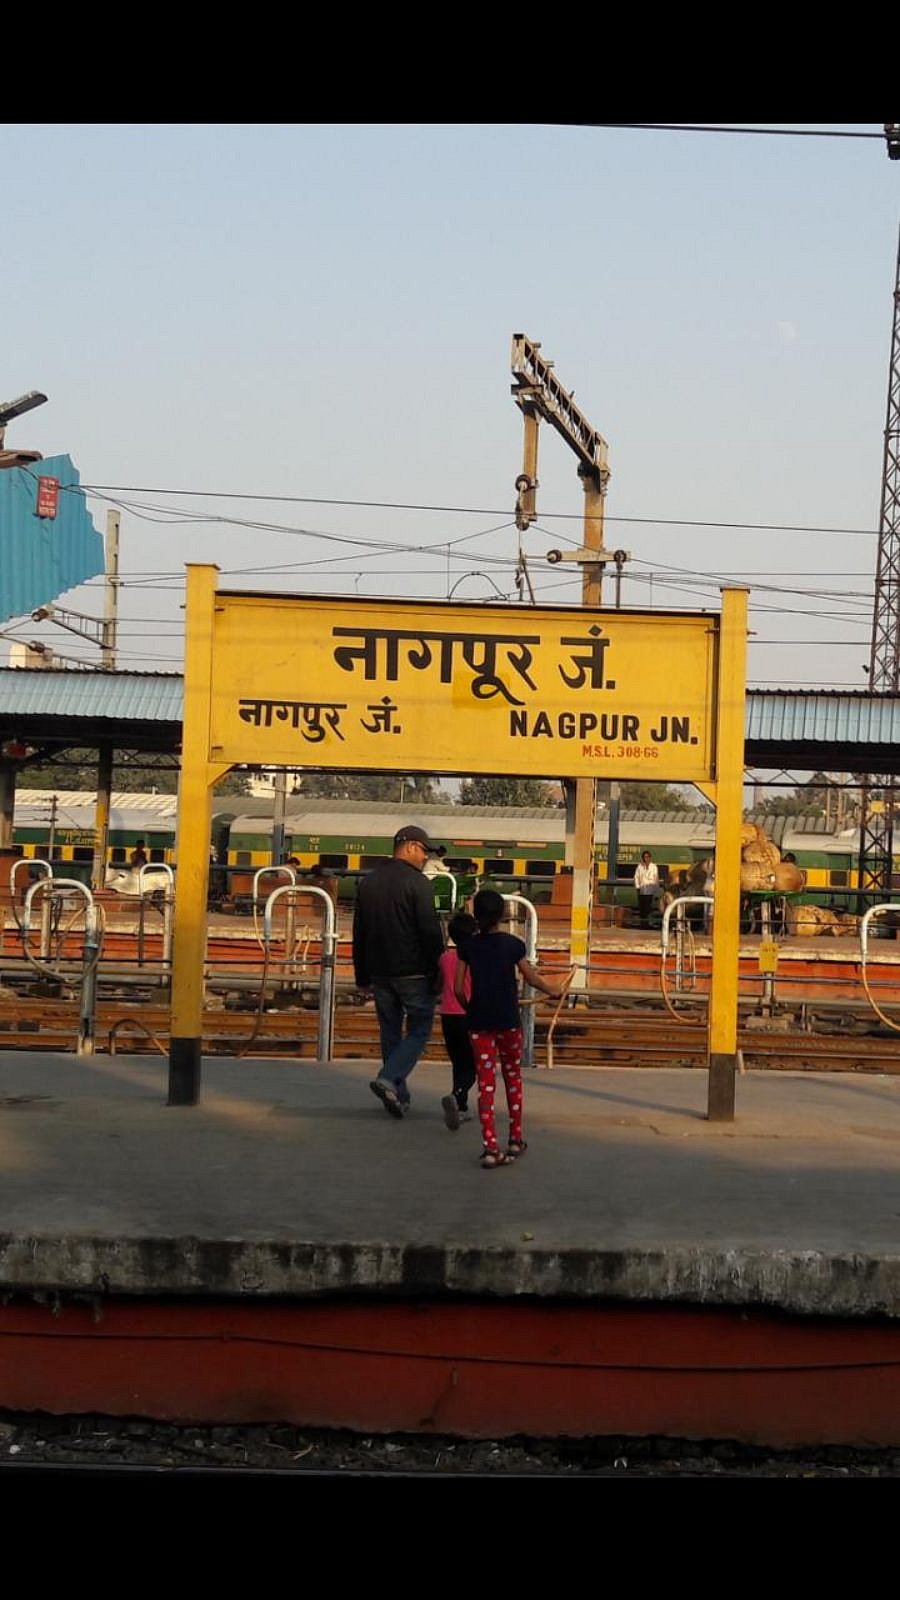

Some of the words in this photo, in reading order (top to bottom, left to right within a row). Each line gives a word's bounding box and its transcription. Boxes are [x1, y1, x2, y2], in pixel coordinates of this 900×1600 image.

[333, 627, 540, 706] नागपूर
[239, 699, 347, 742] नागपुर
[510, 710, 640, 741] NAGPUR
[651, 716, 698, 745] JN.
